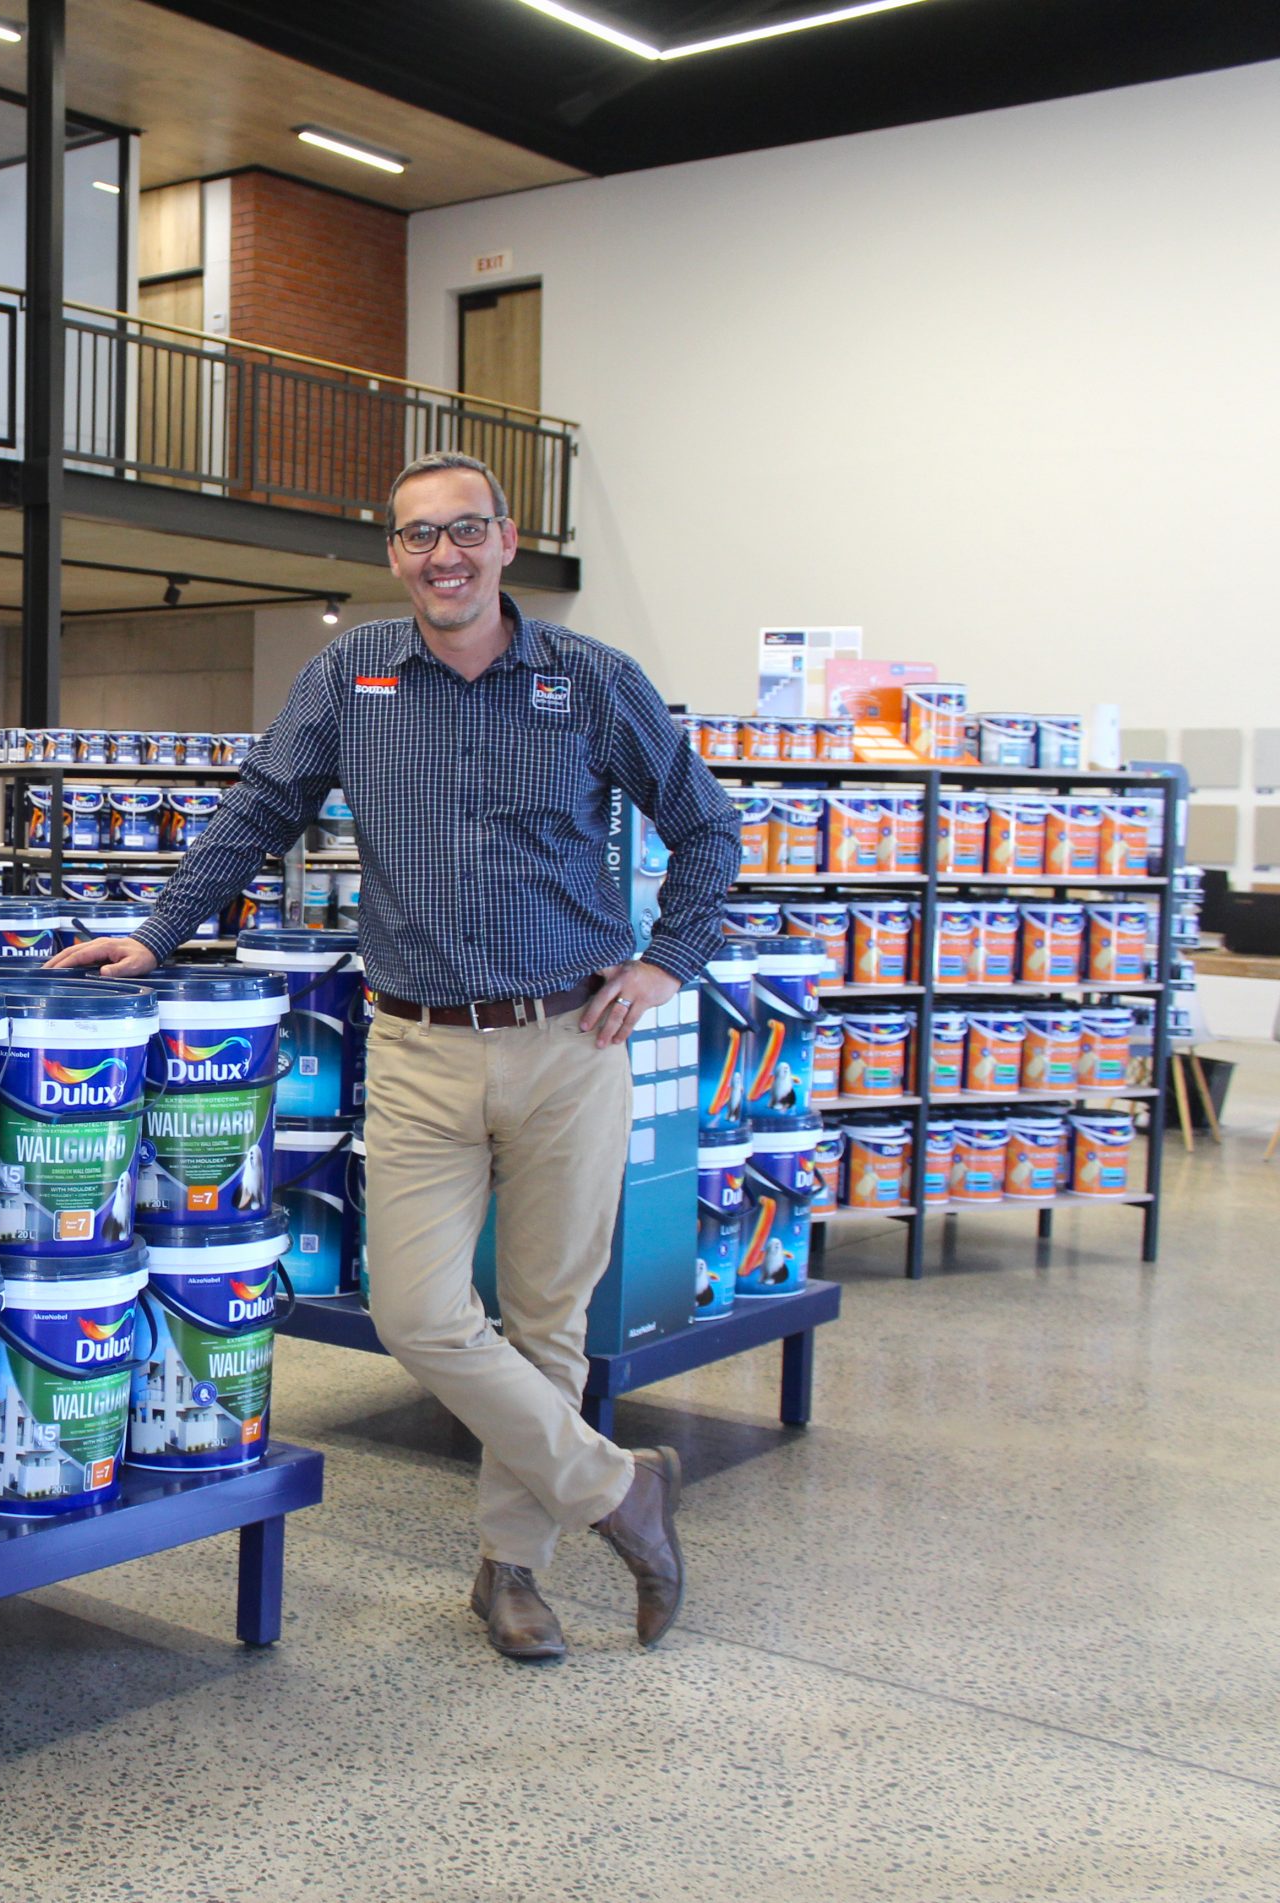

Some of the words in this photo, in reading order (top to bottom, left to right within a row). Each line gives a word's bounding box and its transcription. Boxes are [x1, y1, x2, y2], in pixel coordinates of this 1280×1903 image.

[355, 685, 397, 694] SOUDAL
[167, 1059, 242, 1082] Dulux
[40, 1081, 118, 1106] Dulux
[147, 1109, 254, 1138] WALLGUARD
[16, 1134, 126, 1164] WALLGUARD
[1, 1165, 21, 1183] 15
[203, 1192, 213, 1205] 7
[77, 1218, 87, 1231] 7
[17, 1230, 29, 1239] 20
[29, 1230, 35, 1239] L
[187, 1277, 221, 1285] AkzoNobel
[228, 1296, 275, 1323] Dulux
[75, 1336, 131, 1364] Dulux
[37, 1425, 56, 1441] 15
[252, 1422, 259, 1436] 7
[104, 1465, 110, 1479] 7
